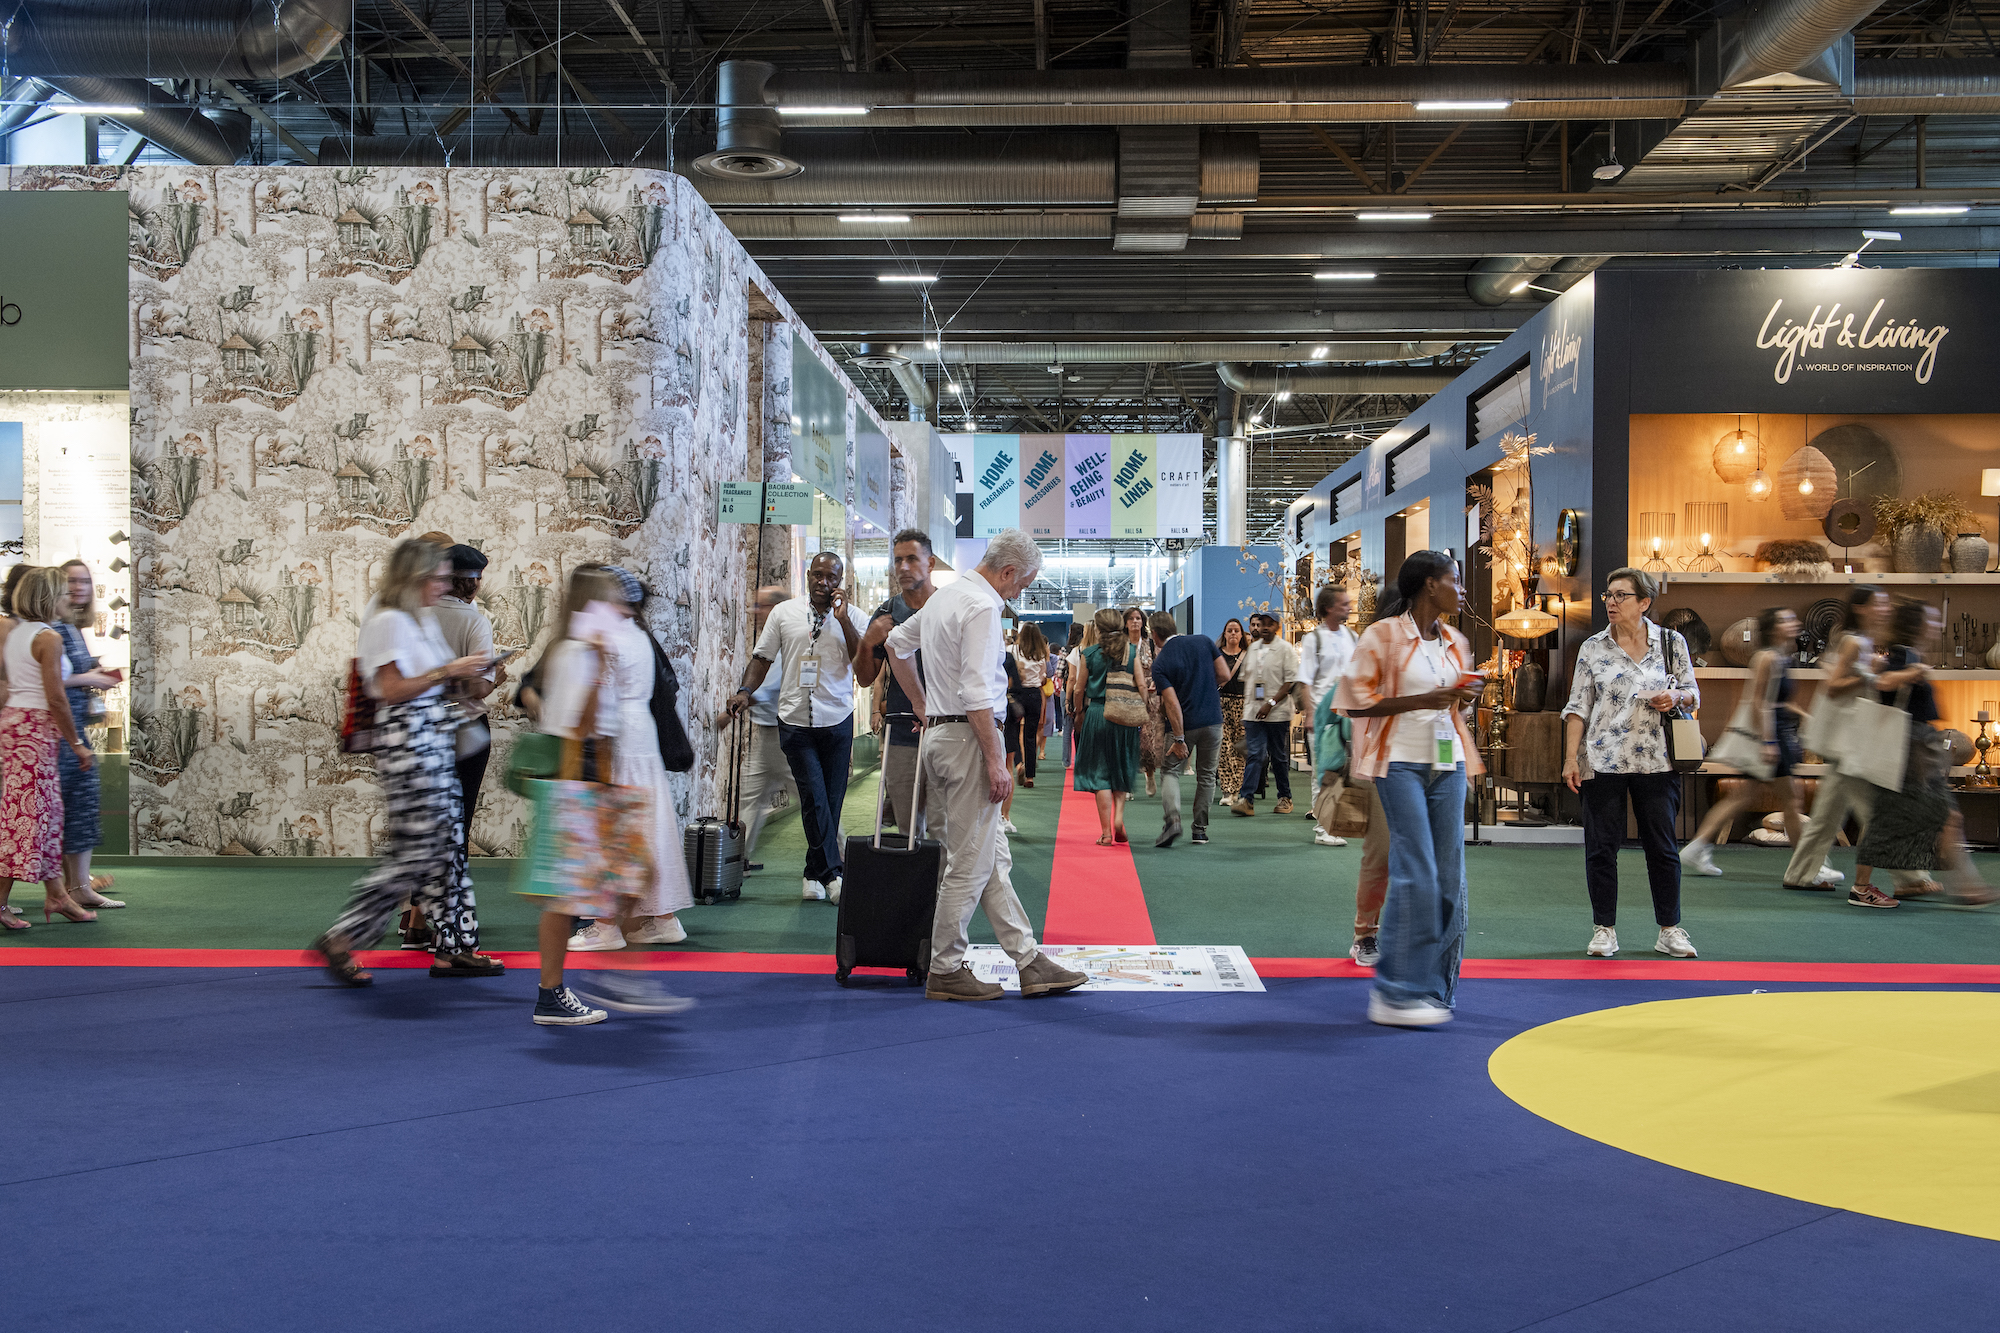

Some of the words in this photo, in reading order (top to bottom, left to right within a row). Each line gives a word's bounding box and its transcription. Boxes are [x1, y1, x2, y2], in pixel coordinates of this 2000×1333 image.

[1756, 298, 1842, 384] Light
[1836, 312, 1858, 349] &
[1858, 298, 1950, 384] Living
[1540, 329, 1558, 410] Light
[1560, 318, 1582, 394] Living
[1796, 363, 1804, 371] A
[1805, 363, 1840, 371] WORLD
[1841, 363, 1854, 371] OF
[1856, 363, 1913, 371] INSPIRATION
[979, 450, 1014, 490] HOME
[1024, 450, 1058, 490] HOME
[1074, 451, 1107, 476] WELL-
[1114, 448, 1148, 490] HOME
[1161, 471, 1199, 481] CRAFT
[979, 478, 1015, 510] FRAGRANCES
[1024, 476, 1062, 510] ACCESSORIES
[1070, 470, 1104, 498] BEING
[1076, 488, 1106, 508] BEAUTY
[1119, 476, 1154, 509] LINEN
[722, 505, 727, 513] A
[729, 505, 734, 513] 6
[1167, 539, 1182, 549] 5A
